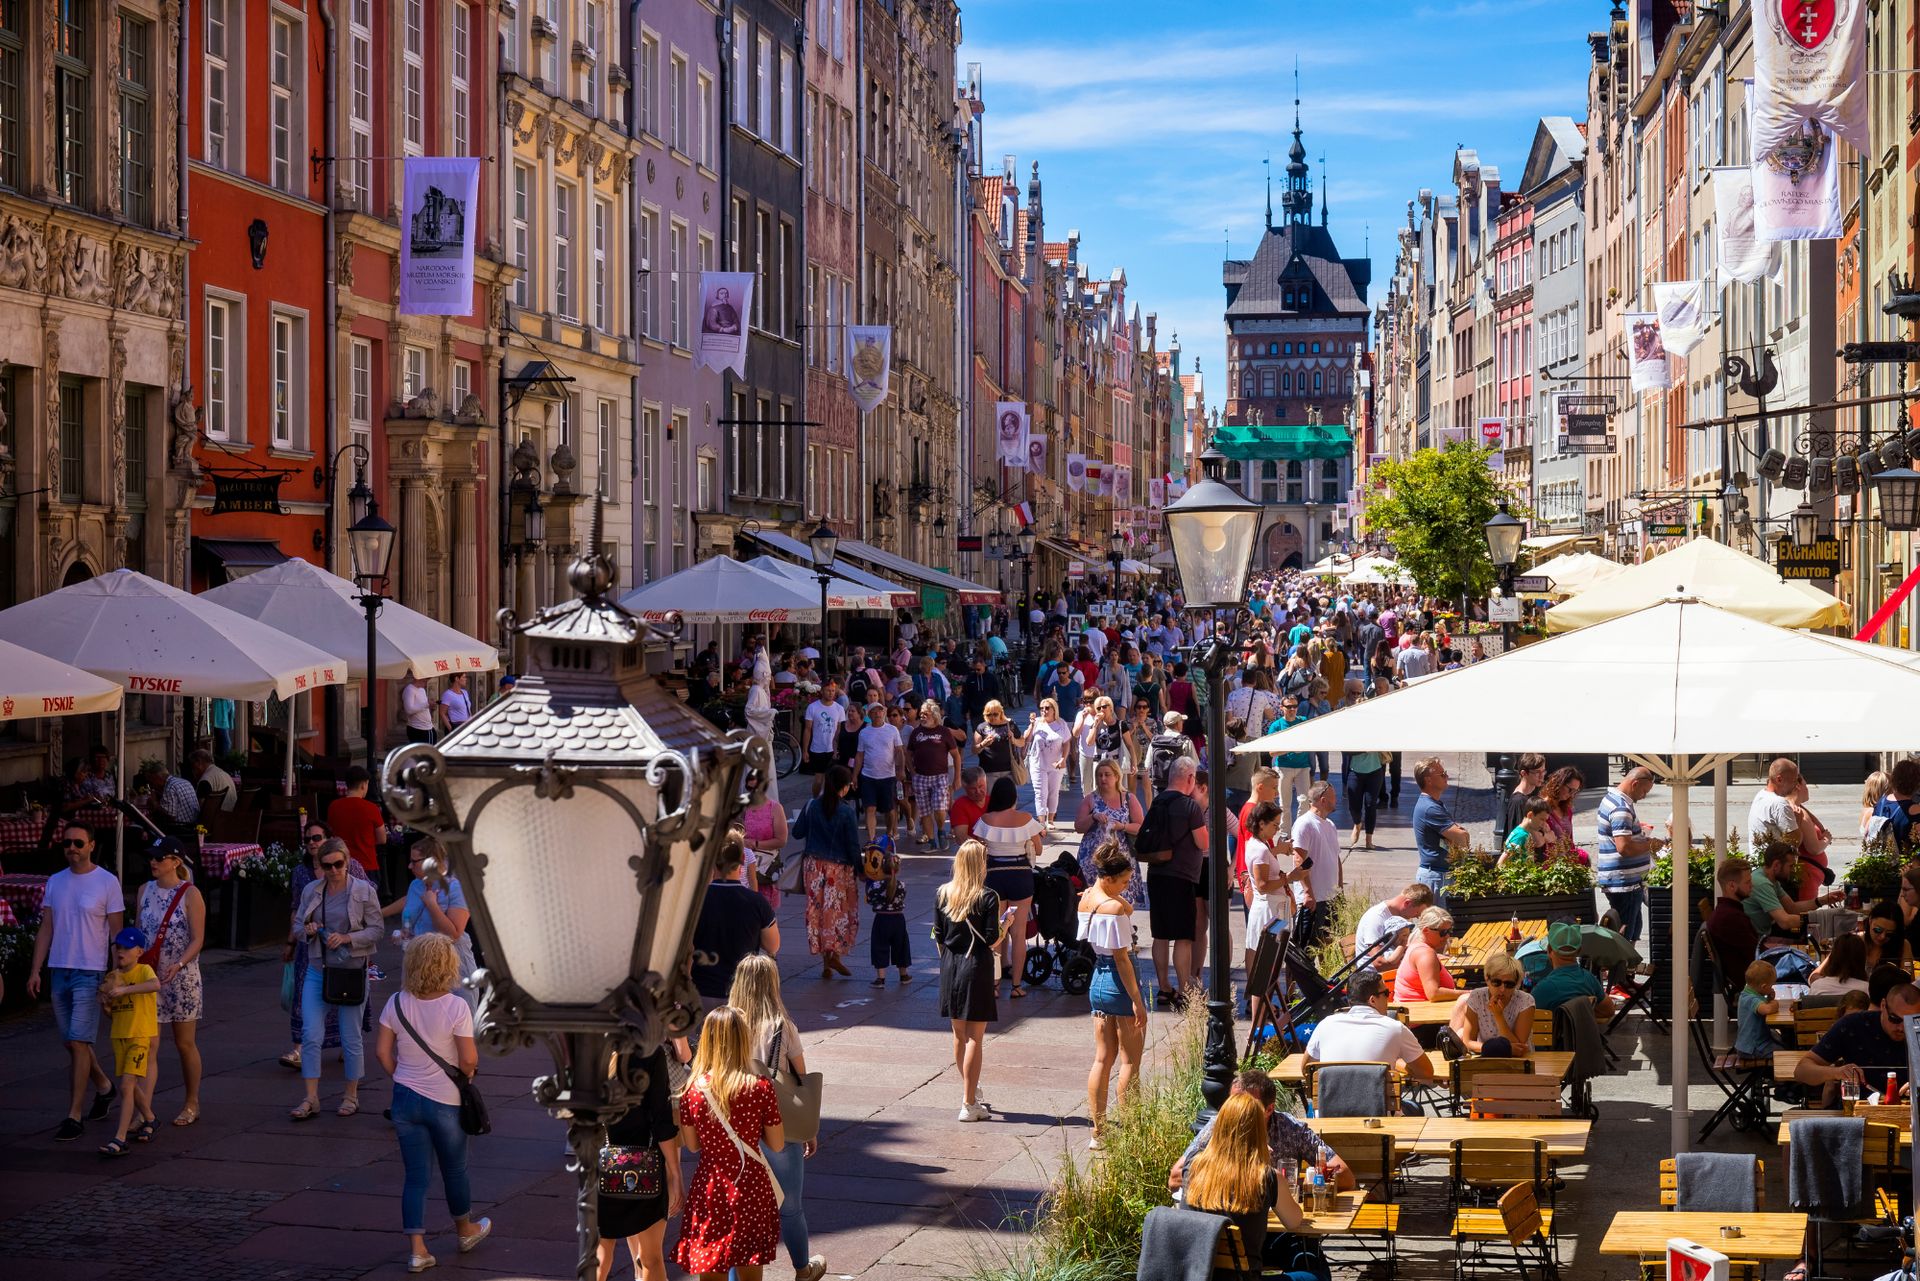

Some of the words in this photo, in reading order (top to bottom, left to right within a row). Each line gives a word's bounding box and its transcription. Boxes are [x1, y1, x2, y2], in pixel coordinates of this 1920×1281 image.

[219, 500, 273, 510] AMBER
[1652, 526, 1685, 535] SUBWAY
[1780, 541, 1839, 560] EXCHANGE
[1784, 566, 1830, 578] KANTOR
[128, 676, 182, 693] TYSKIE
[42, 696, 74, 712] TYSKIE
